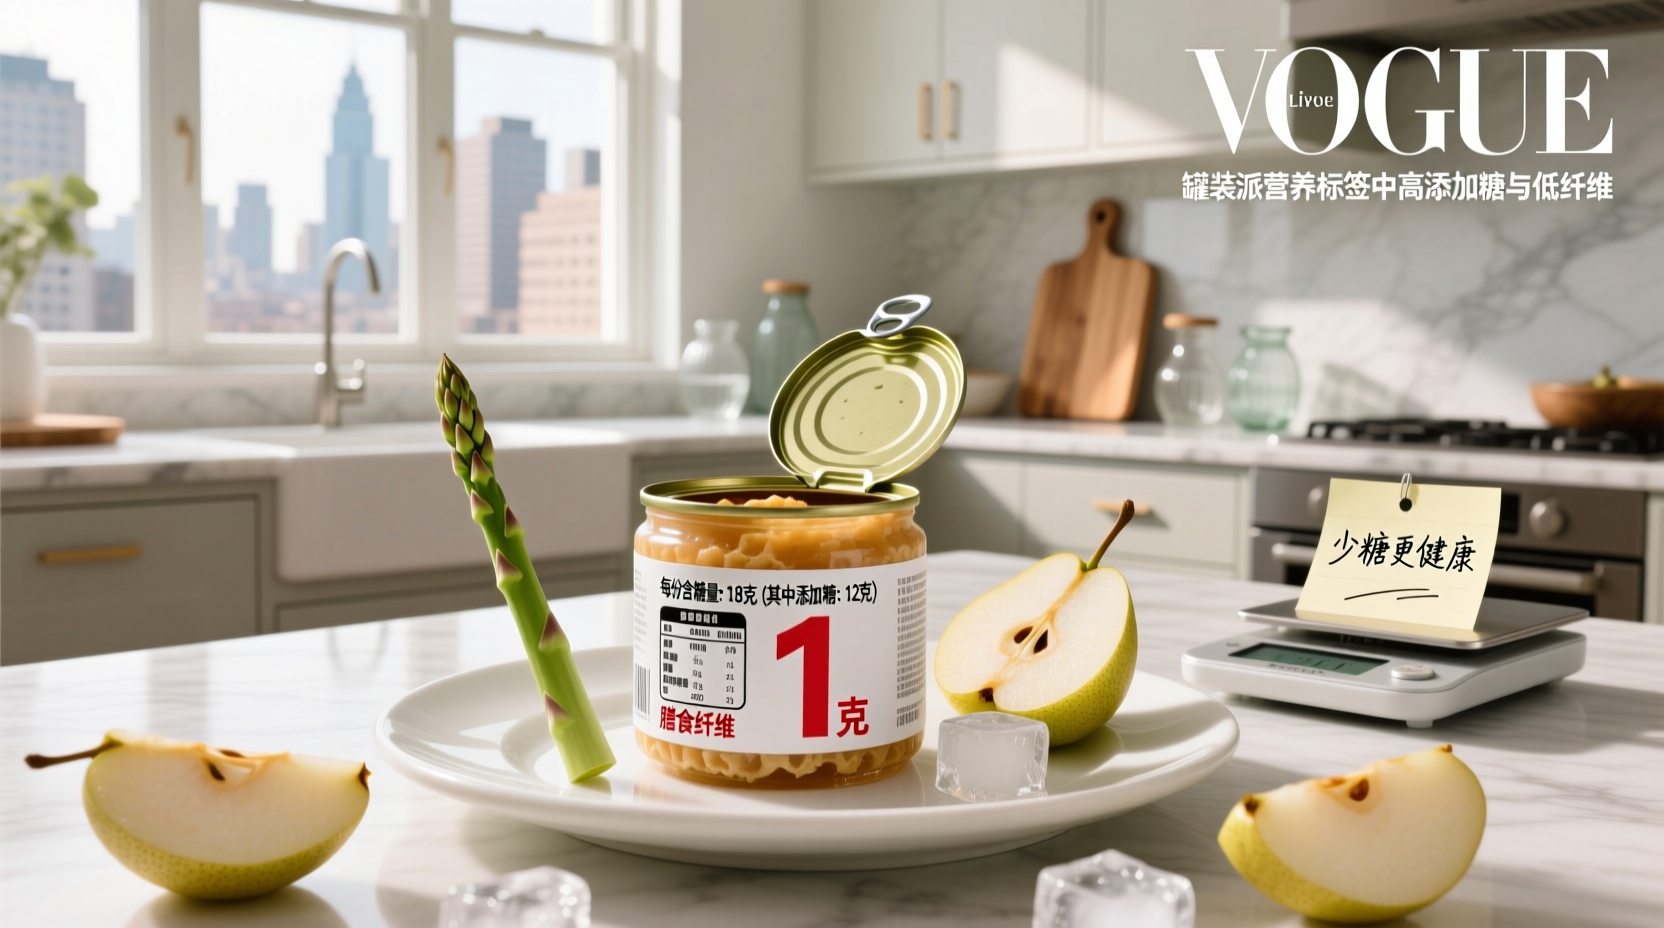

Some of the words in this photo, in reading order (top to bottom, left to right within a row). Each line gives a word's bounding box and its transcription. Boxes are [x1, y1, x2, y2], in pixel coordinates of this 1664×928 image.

[1328, 529, 1477, 573] 少糖更健康
[727, 583, 758, 606] 18克
